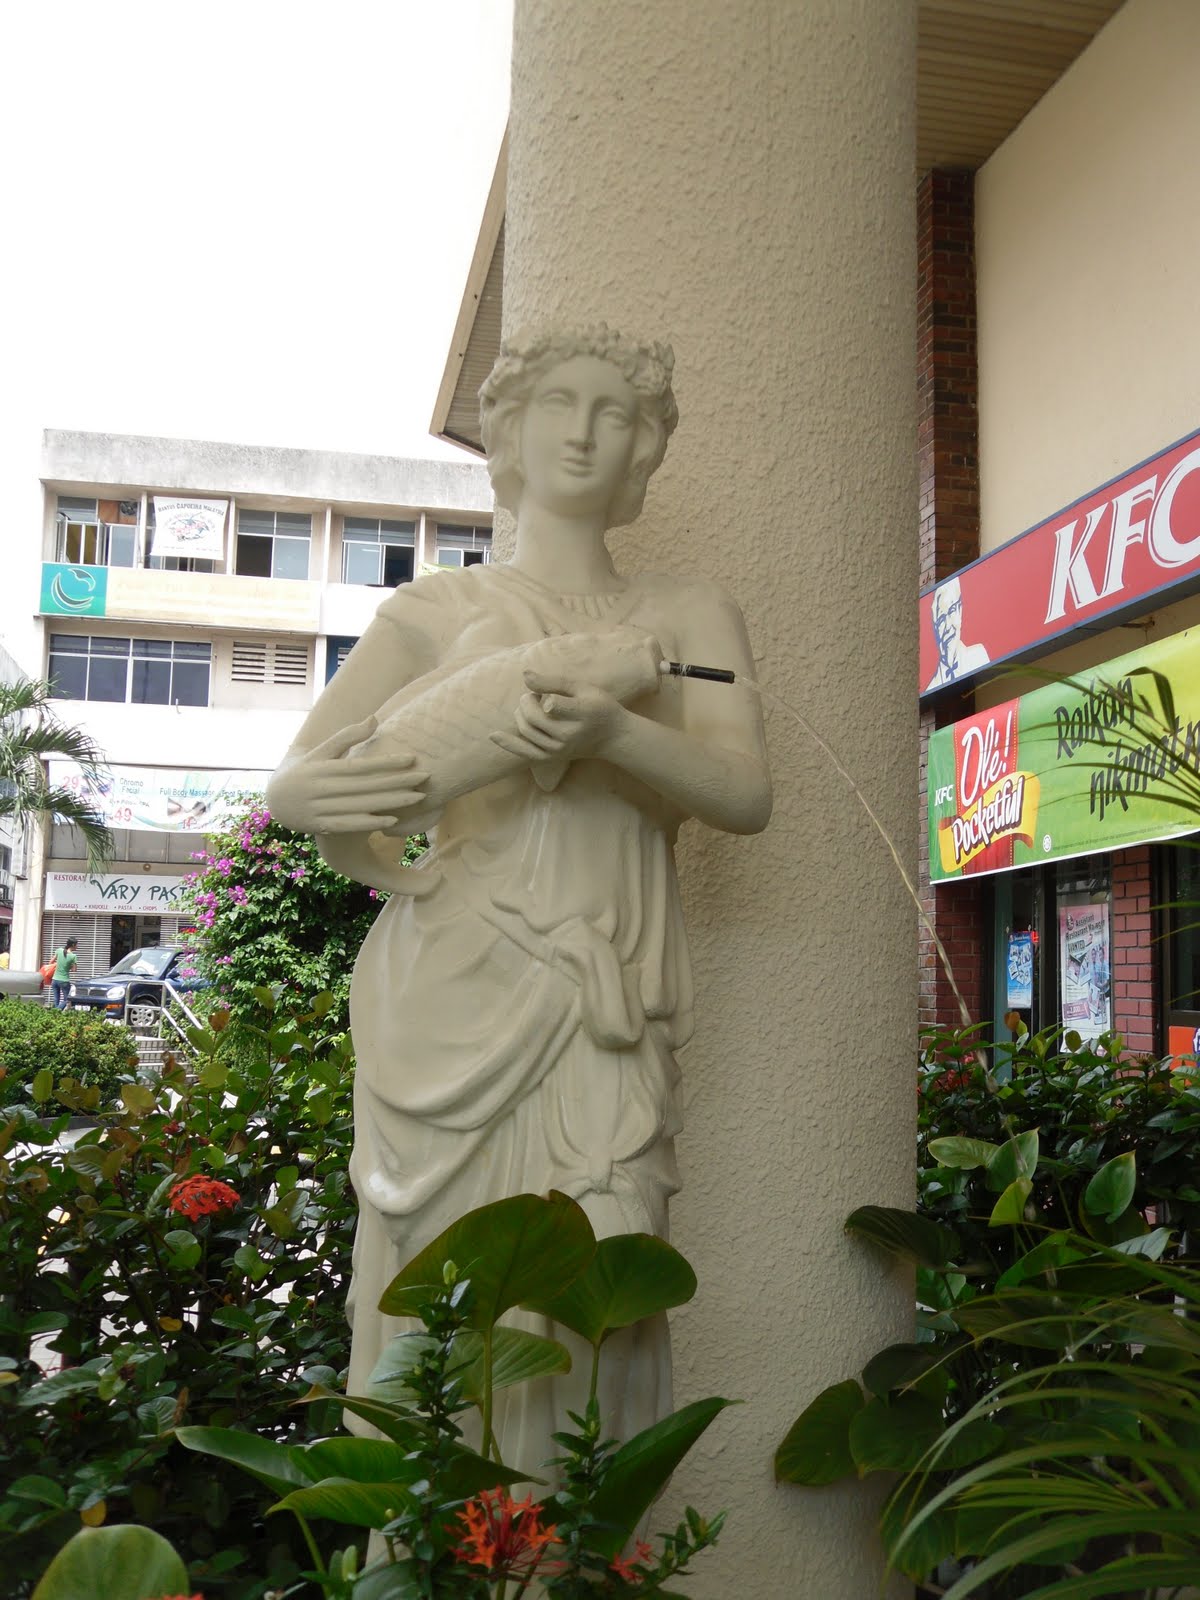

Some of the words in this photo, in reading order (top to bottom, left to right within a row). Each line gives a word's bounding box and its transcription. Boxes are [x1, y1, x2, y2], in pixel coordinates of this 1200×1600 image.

[1044, 447, 1200, 625] KFC
[960, 710, 1013, 808] Olé!
[1053, 677, 1135, 761] Raikan
[159, 787, 172, 796] Full
[173, 788, 188, 798] Body
[934, 784, 954, 807] KFC
[951, 775, 1025, 865] Pocketful
[90, 878, 141, 904] VARY
